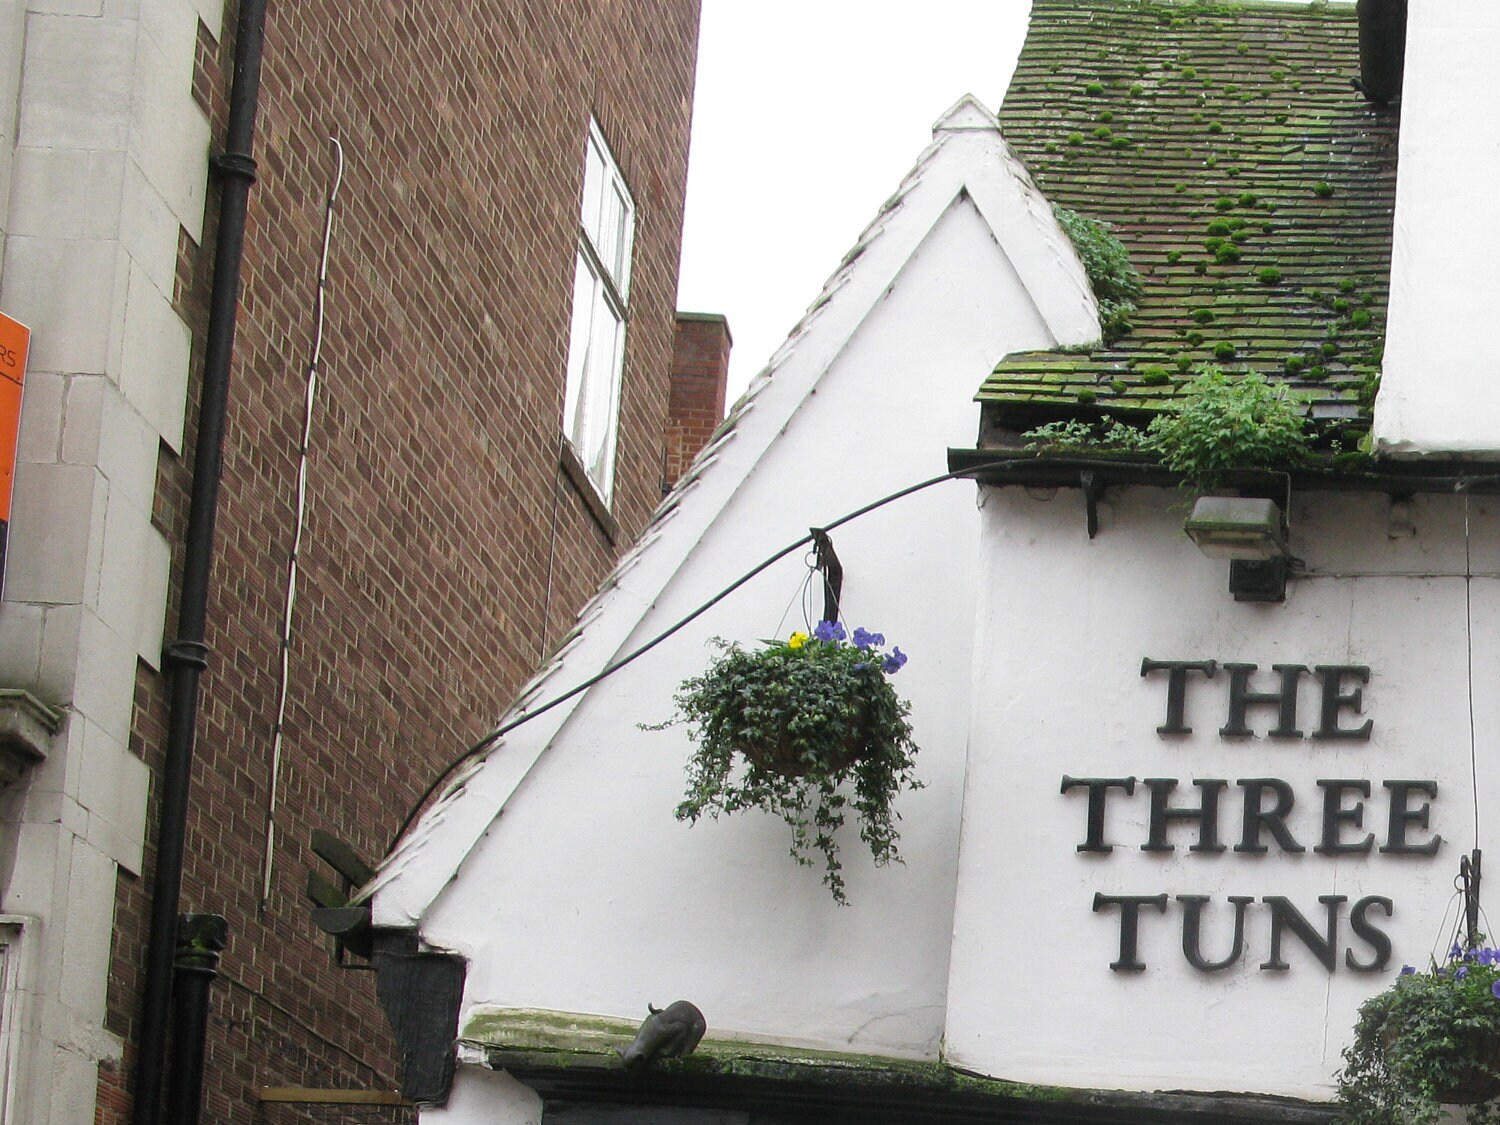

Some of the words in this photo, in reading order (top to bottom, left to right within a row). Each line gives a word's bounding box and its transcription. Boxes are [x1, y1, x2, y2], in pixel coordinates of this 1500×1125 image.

[1140, 656, 1375, 741] THE
[1060, 774, 1443, 857] THREE
[1092, 891, 1394, 974] TUNS
